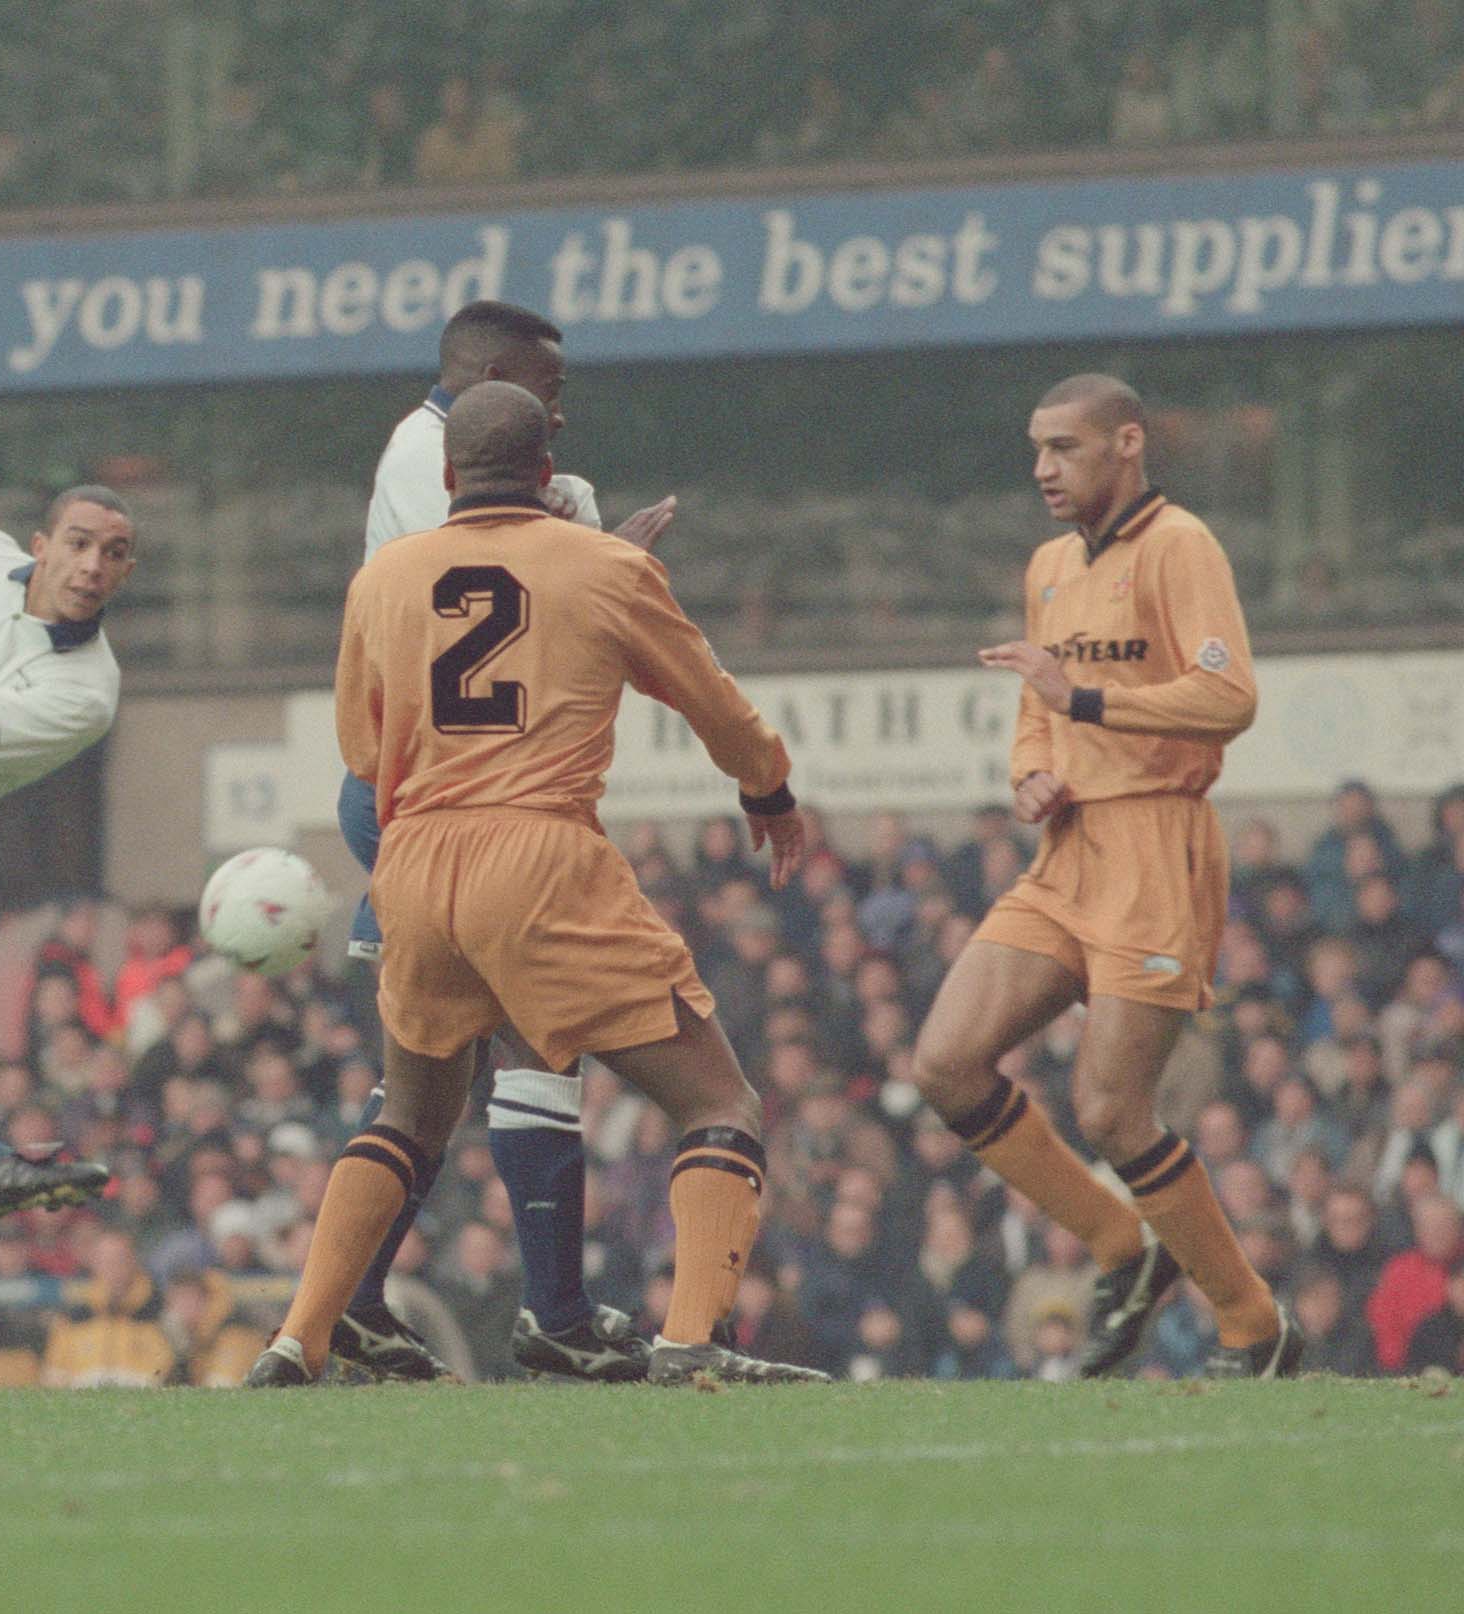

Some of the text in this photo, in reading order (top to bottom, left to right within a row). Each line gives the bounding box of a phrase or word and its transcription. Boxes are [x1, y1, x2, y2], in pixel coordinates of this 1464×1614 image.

[8, 273, 206, 373] you
[250, 224, 511, 341] need
[548, 216, 723, 323] the
[757, 208, 1001, 315] best
[431, 565, 530, 735] 2
